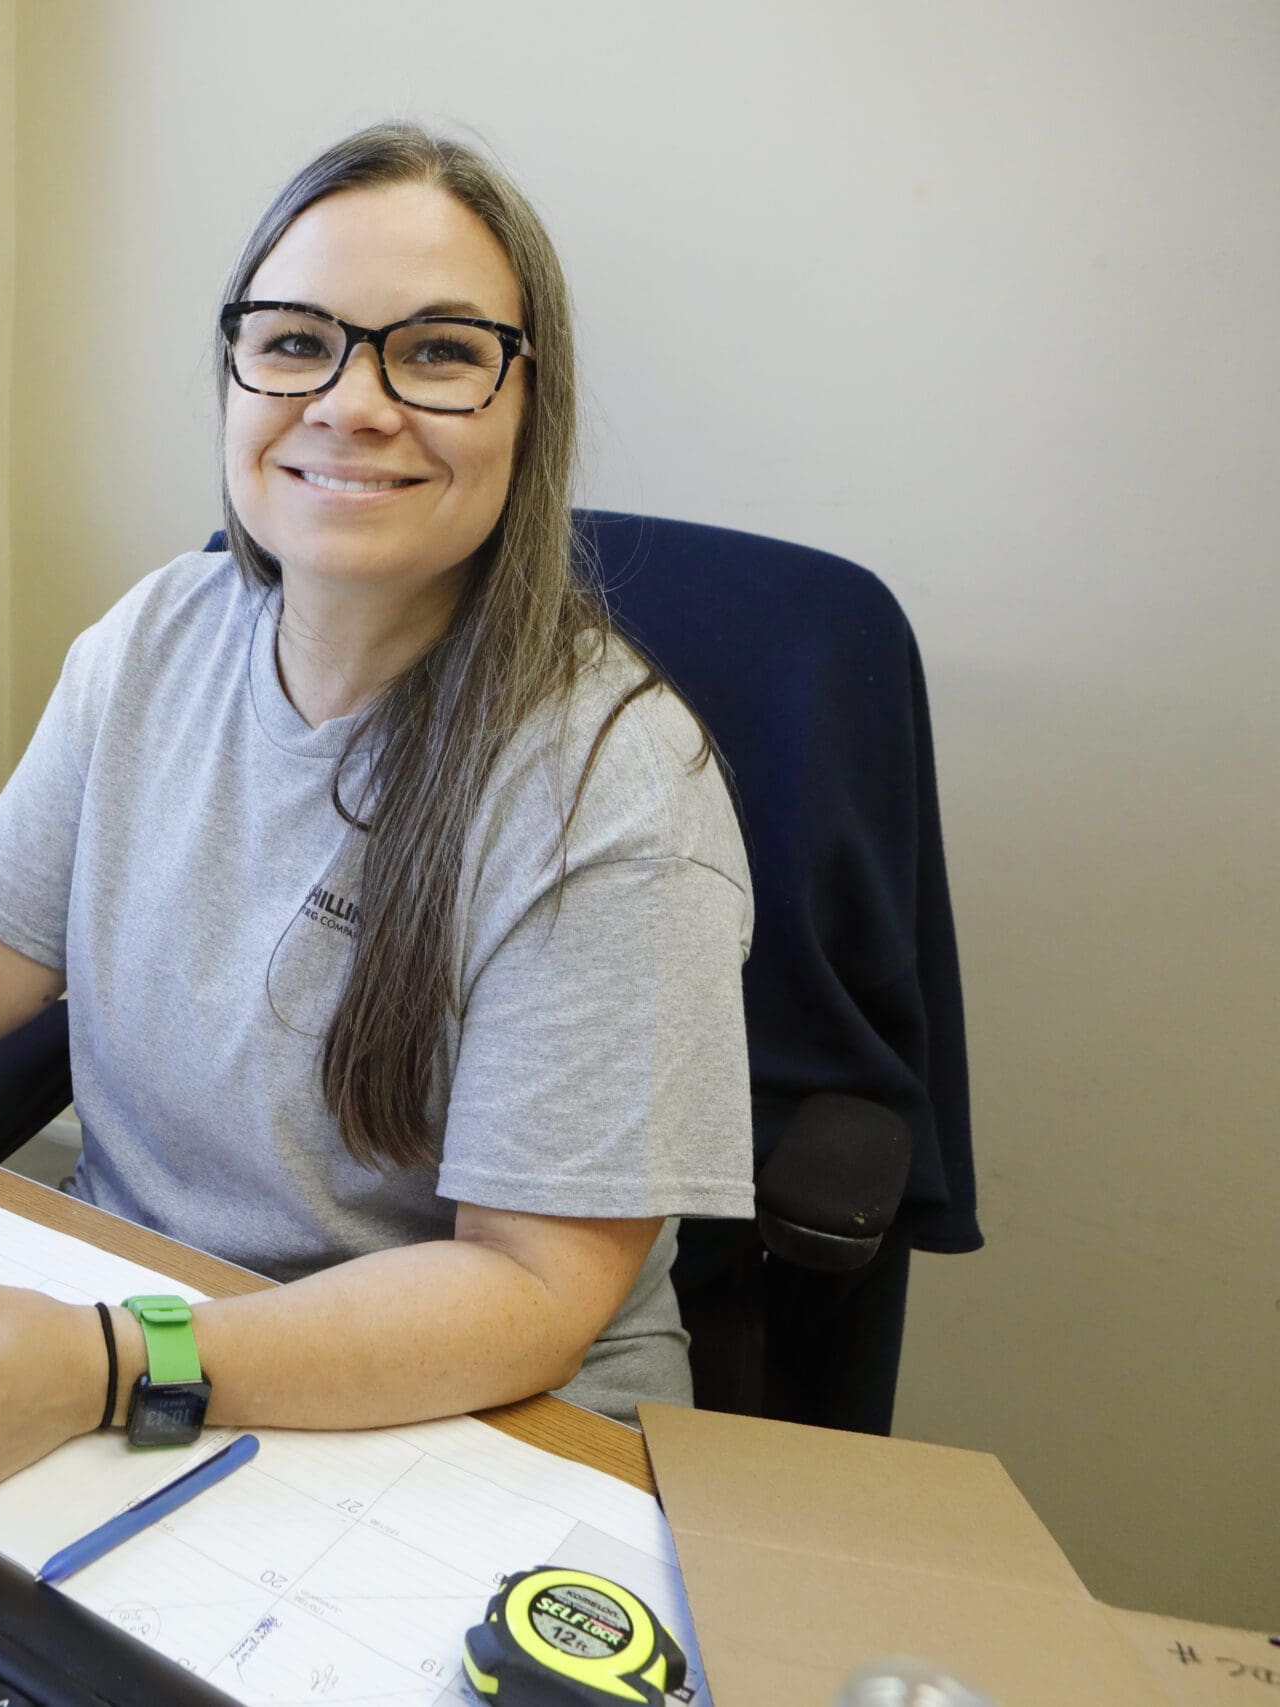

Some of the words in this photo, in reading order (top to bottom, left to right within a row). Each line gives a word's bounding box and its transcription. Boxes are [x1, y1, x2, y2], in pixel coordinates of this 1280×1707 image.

[320, 915, 357, 938] COMPA
[146, 1409, 190, 1427] 10:43
[336, 1498, 364, 1514] 27
[260, 1570, 287, 1588] 20
[535, 1596, 588, 1625] SELF
[582, 1619, 623, 1647] LOCK
[551, 1626, 577, 1647] 12
[421, 1658, 445, 1677] 19
